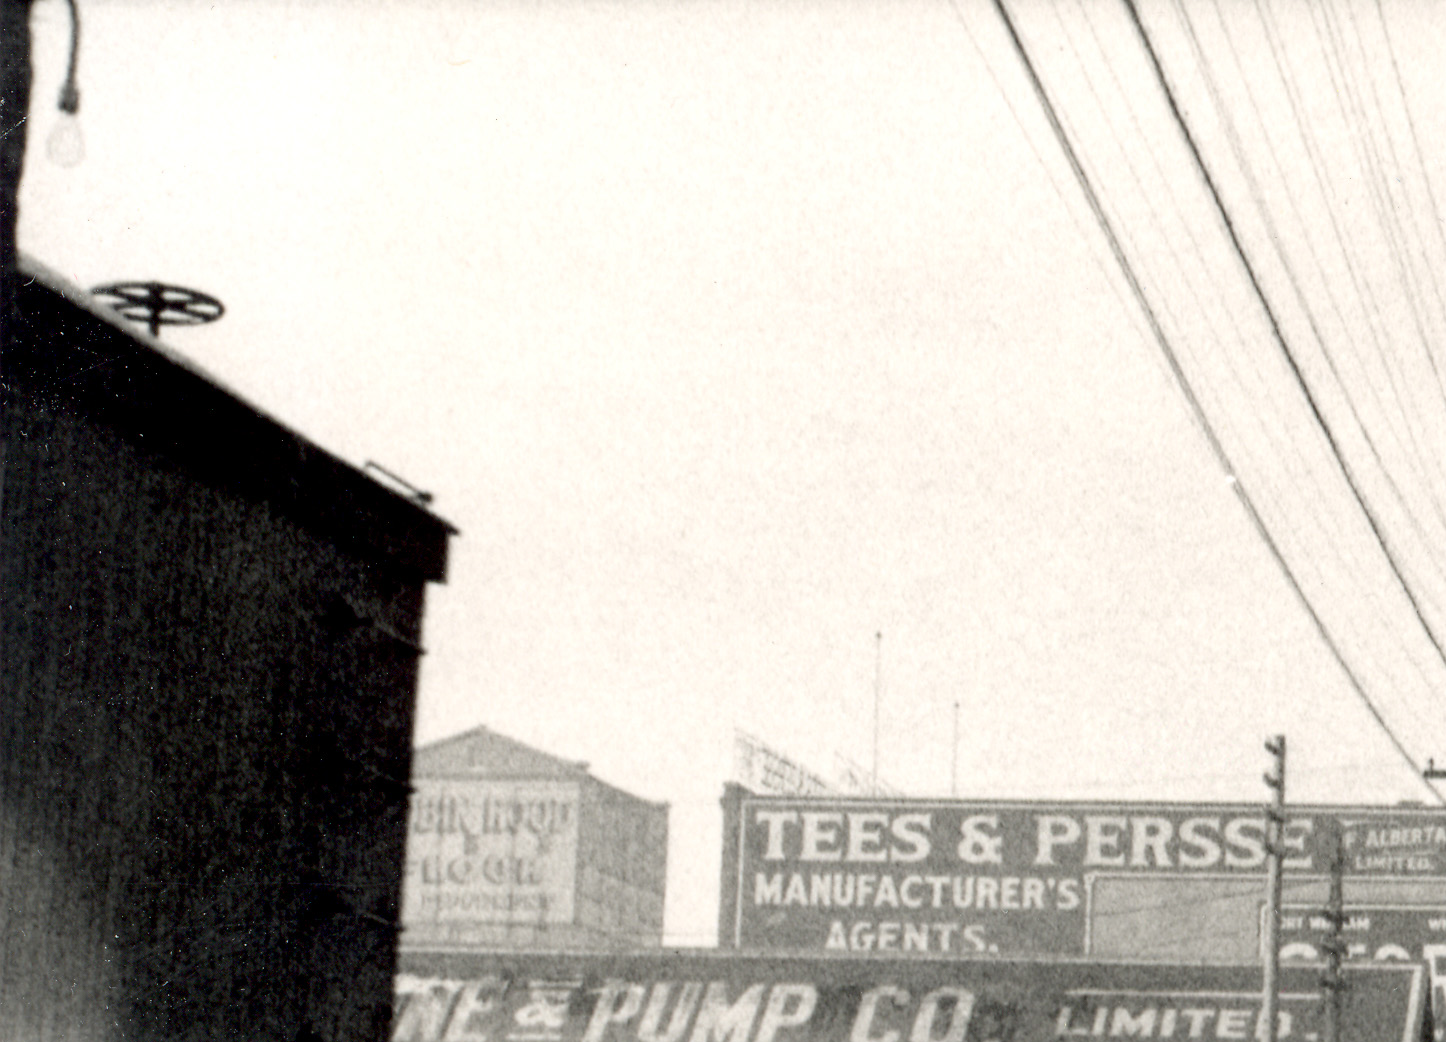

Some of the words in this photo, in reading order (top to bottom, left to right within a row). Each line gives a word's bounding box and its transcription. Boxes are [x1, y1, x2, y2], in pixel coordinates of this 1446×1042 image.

[756, 811, 932, 861] TEES
[957, 814, 1002, 864] &
[1034, 815, 1313, 868] PERSSE
[1365, 826, 1446, 848] ALBERTA
[755, 872, 1080, 910] MANUFACTURER'S
[825, 921, 999, 953] AGENTS.
[1309, 915, 1369, 931] WIAM
[1054, 1006, 1319, 1042] LIMITED.
